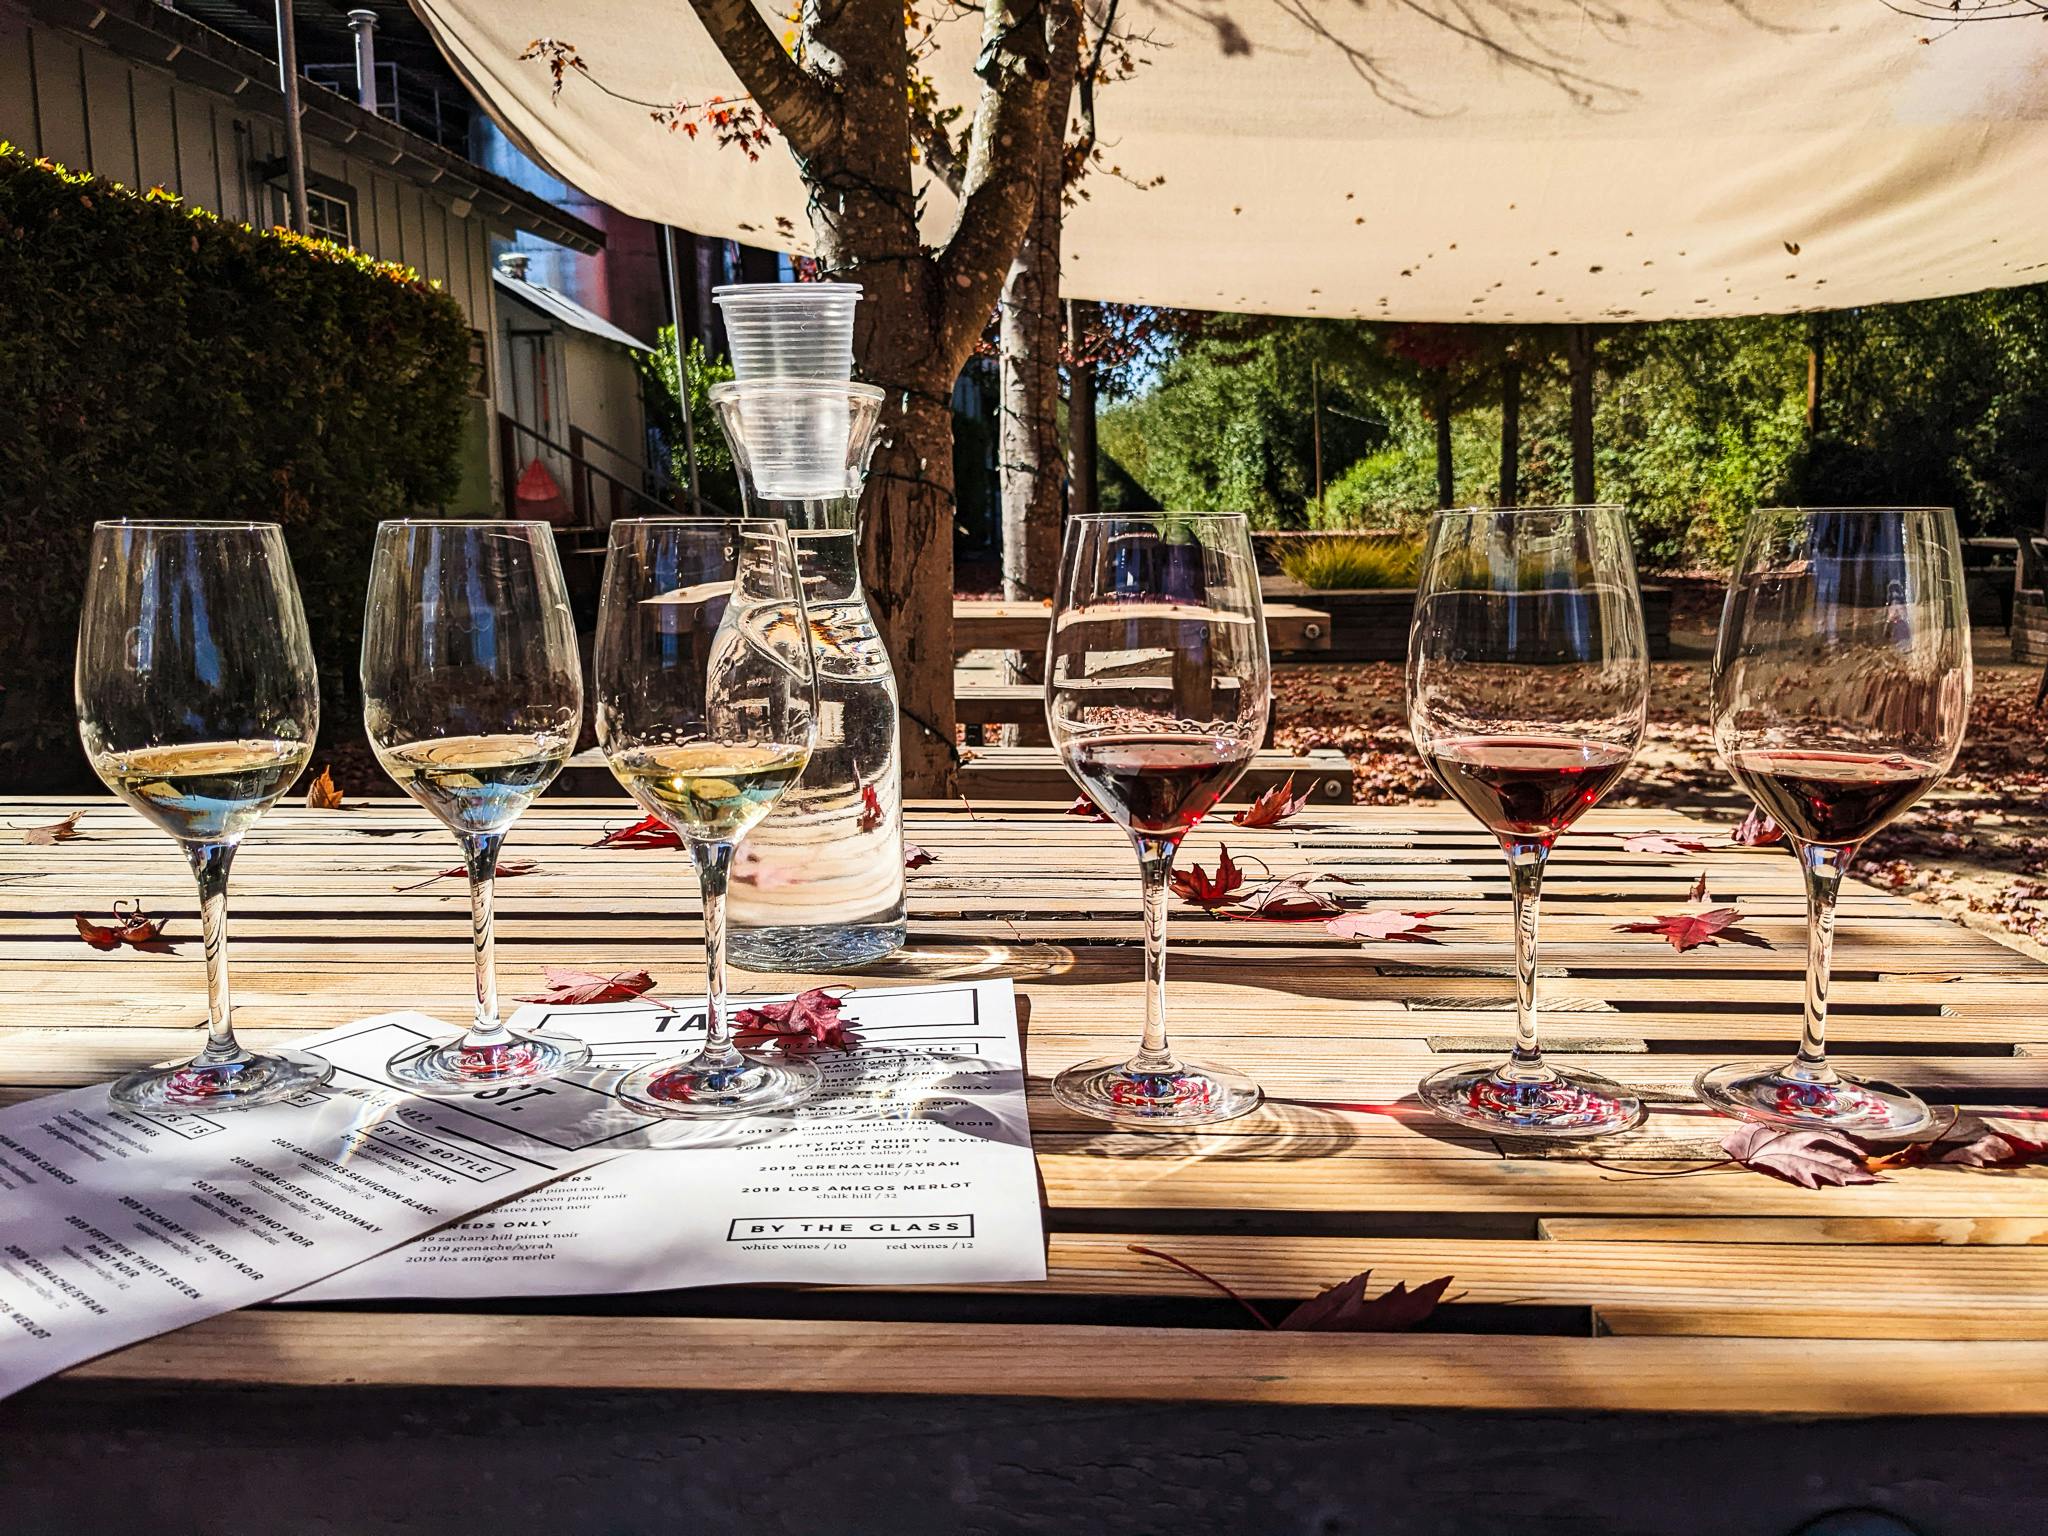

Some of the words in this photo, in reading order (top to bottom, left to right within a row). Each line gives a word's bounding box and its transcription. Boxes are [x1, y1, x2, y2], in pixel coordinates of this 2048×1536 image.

[824, 1059, 907, 1069] SAUVIGNON
[188, 1125, 209, 1135] 15
[779, 1124, 853, 1133] ZACHARY
[375, 1126, 400, 1136] BY
[400, 1135, 430, 1150] THE
[429, 1148, 492, 1174] BOTTLE
[363, 1142, 423, 1170] SAUVIGNON
[420, 1167, 457, 1185] BLANC
[804, 1161, 961, 1170] GRENACHE/SYRAH
[38, 1161, 78, 1185] CLASSICS
[272, 1138, 295, 1150] 2021
[292, 1147, 349, 1175] GARAGISTES
[346, 1172, 404, 1200] SAUVIGNON
[402, 1197, 438, 1216] BLANC
[868, 1169, 903, 1177] valley
[903, 1182, 973, 1191] MERLOT
[230, 1156, 254, 1169] 2019
[252, 1166, 312, 1200] GARAGISTES
[310, 1197, 383, 1233] CHARDONNAY
[192, 1180, 217, 1194] 2021
[214, 1191, 243, 1208] ROSE
[240, 1206, 258, 1217] OF
[253, 1213, 288, 1232] PINOT
[284, 1231, 314, 1248] NOIR
[530, 1204, 562, 1213] pinot
[448, 1222, 496, 1230] REDS
[503, 1220, 551, 1228] ONLY
[750, 1224, 785, 1233] BY
[801, 1224, 854, 1232] THE
[869, 1222, 960, 1231] GLASS
[438, 1235, 489, 1243] zachary
[491, 1233, 513, 1241] hill
[515, 1232, 550, 1241] pinot
[553, 1231, 579, 1239] noir
[139, 1207, 186, 1233] ZACHARY
[181, 1231, 205, 1246] HILL
[203, 1243, 238, 1263] PINOT
[234, 1262, 264, 1281] NOIR
[451, 1242, 553, 1253] grenache/syrah
[742, 1242, 779, 1250] white
[783, 1242, 820, 1250] wines
[886, 1242, 908, 1250] red
[84, 1244, 118, 1261] PINOT
[112, 1261, 140, 1279] NOIR
[461, 1254, 510, 1264] amigos
[512, 1252, 556, 1261] merlot
[110, 1242, 136, 1258] FIVE
[132, 1255, 170, 1278] THIRTY
[166, 1276, 203, 1299] SEVEN
